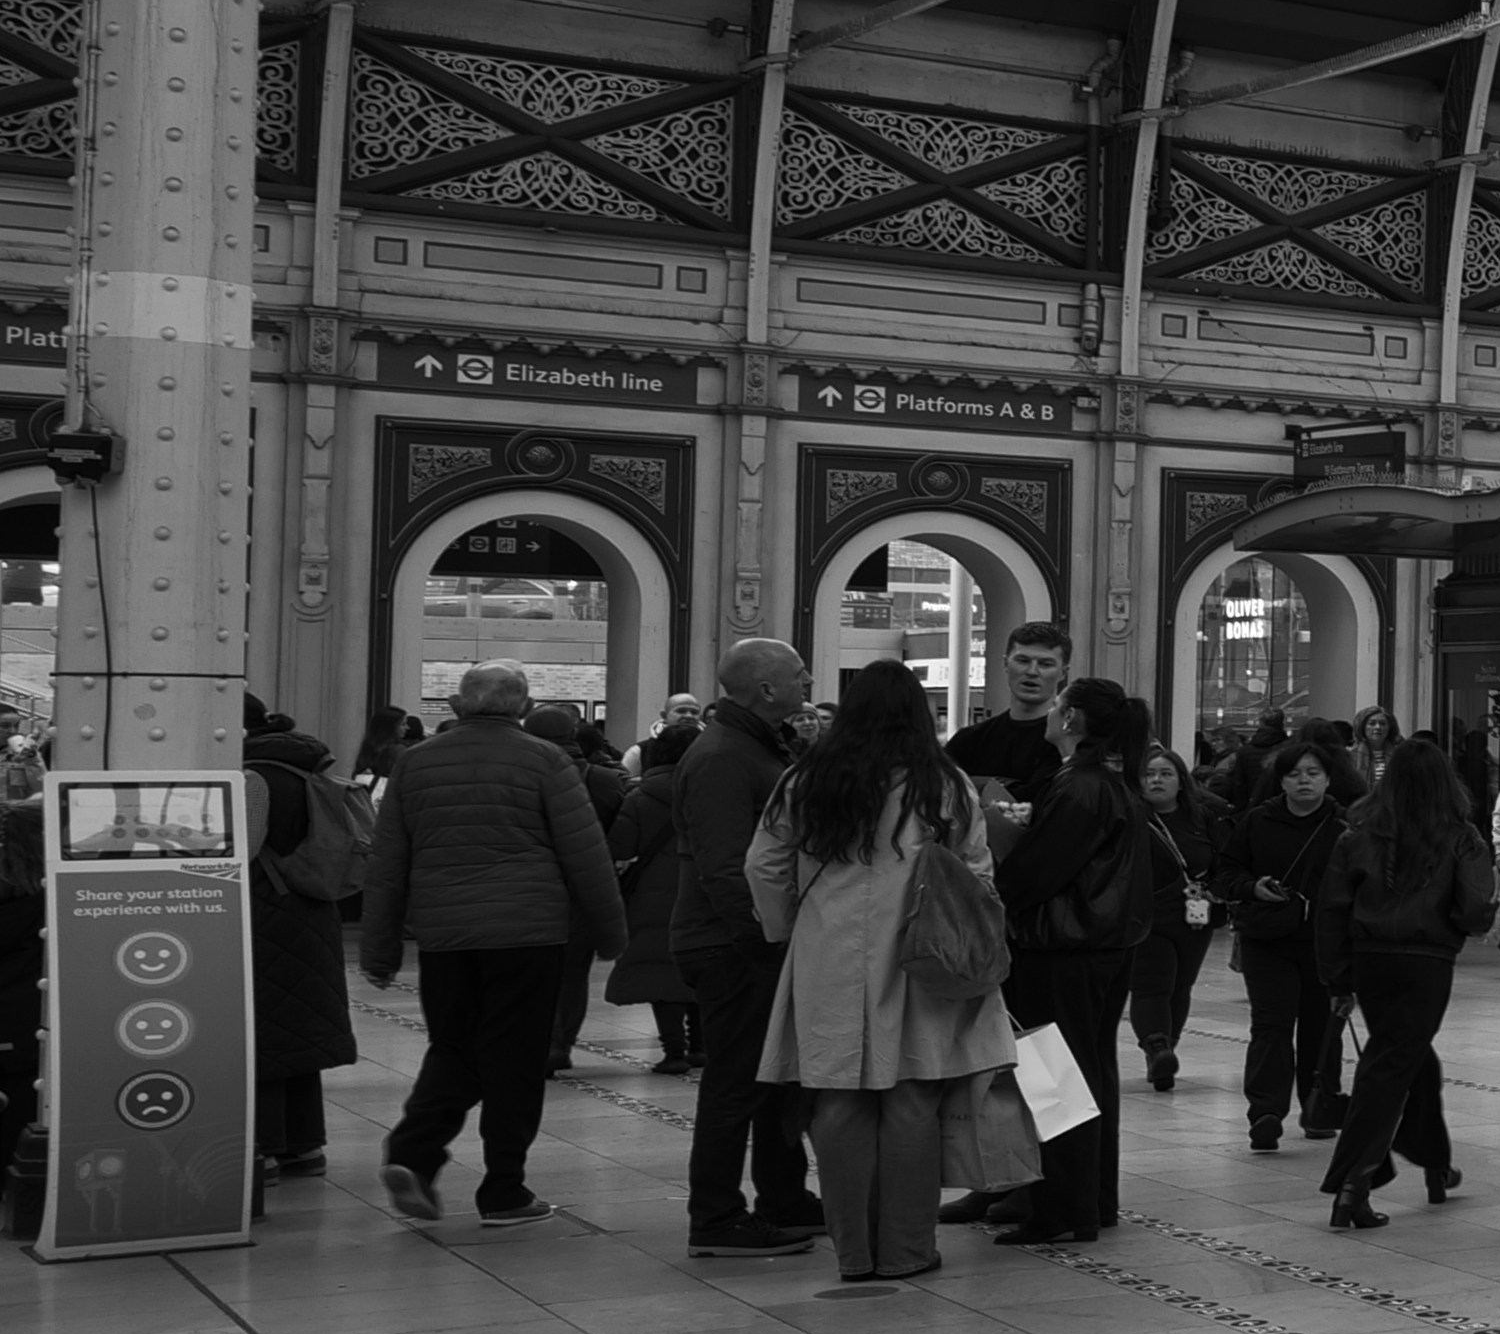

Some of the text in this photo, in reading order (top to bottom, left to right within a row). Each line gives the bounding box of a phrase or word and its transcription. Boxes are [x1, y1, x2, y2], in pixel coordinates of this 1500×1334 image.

[506, 363, 663, 392] Elizabeth line
[896, 393, 1054, 421] Platforms A & B
[1226, 598, 1265, 618] OLIVER
[1226, 619, 1264, 639] BONAS
[75, 887, 224, 903] Share your station
[73, 902, 227, 919] experience with us.
